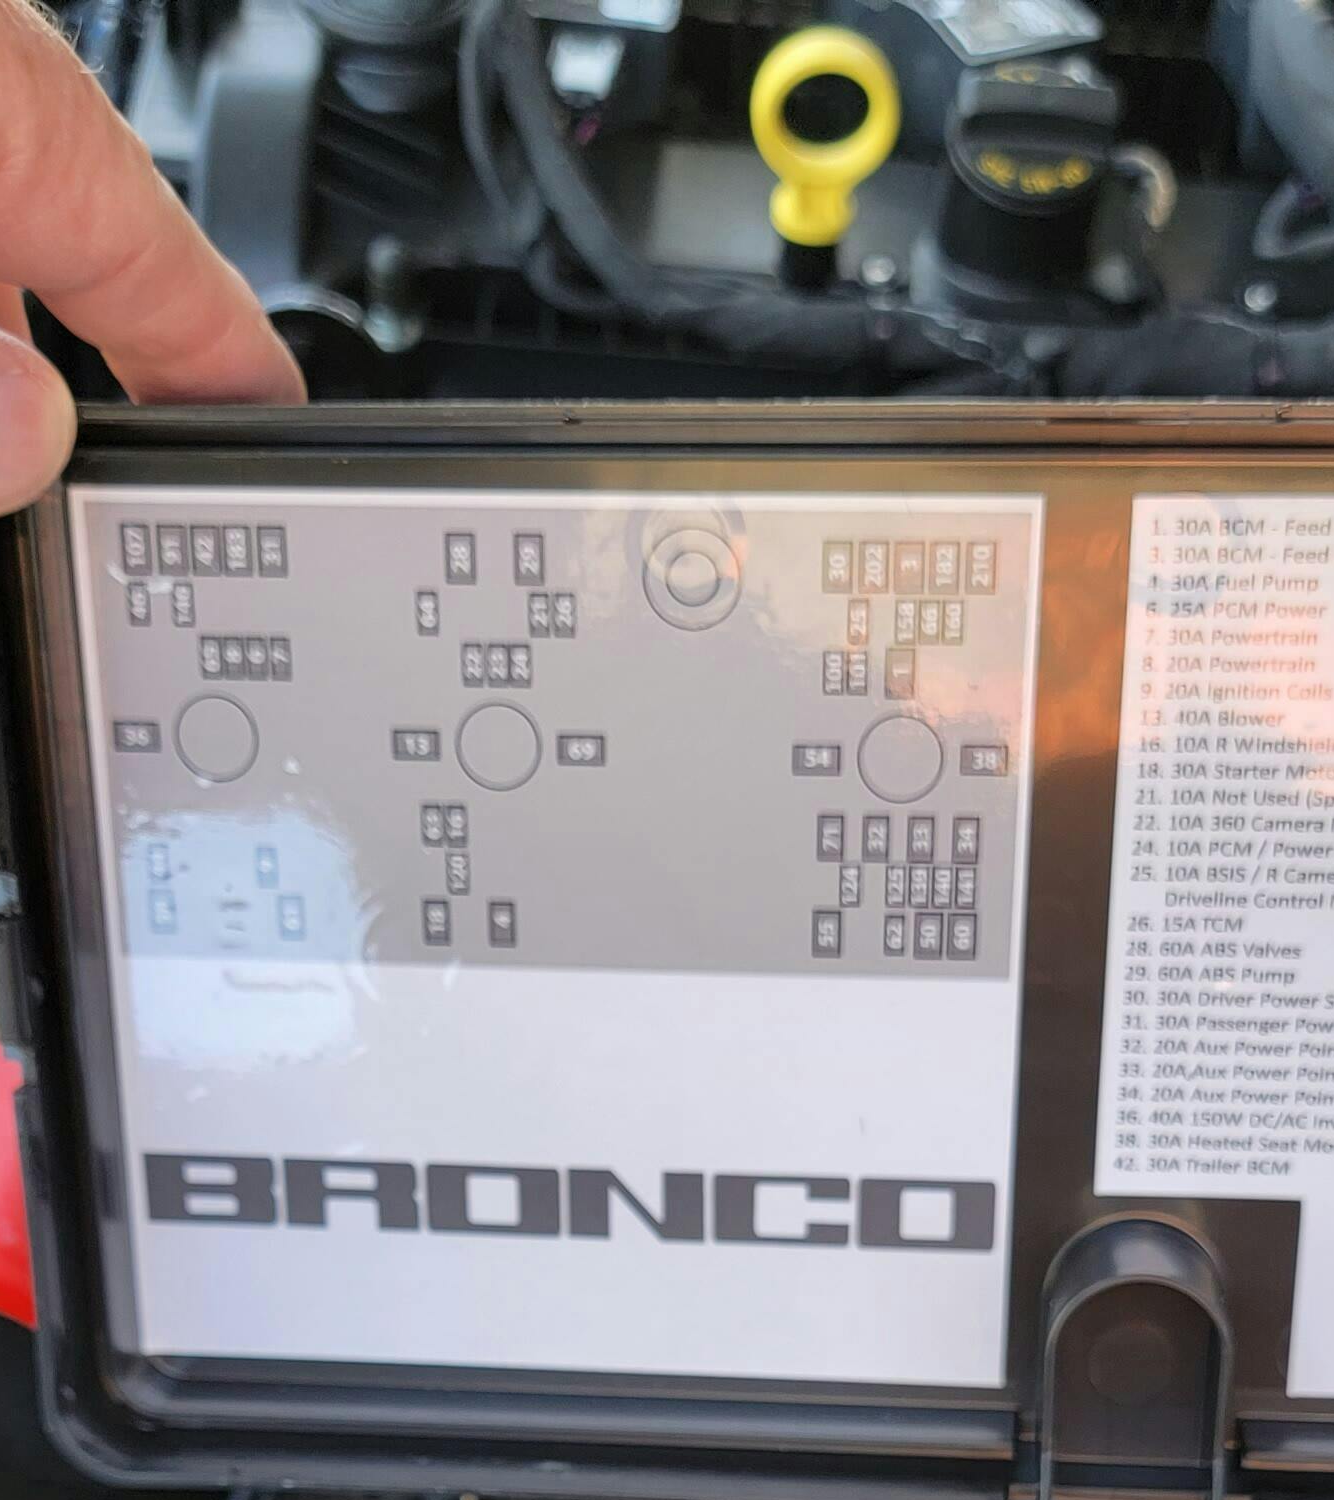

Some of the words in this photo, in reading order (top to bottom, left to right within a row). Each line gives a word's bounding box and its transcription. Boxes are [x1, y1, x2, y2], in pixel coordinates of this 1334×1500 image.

[1133, 813, 1162, 829] 22.
[1166, 813, 1206, 829] 10A
[1211, 813, 1247, 830] 360
[1249, 814, 1326, 830] Camera
[1131, 838, 1161, 854] 24.
[1165, 839, 1204, 855] 10A
[1207, 839, 1253, 855] PCM
[1272, 840, 1334, 856] Power
[1127, 914, 1156, 930] 26.
[1160, 915, 1199, 931] 15A
[1200, 915, 1244, 931] TCM
[1122, 989, 1151, 1004] 30.
[1155, 989, 1193, 1005] 30A
[1196, 990, 1255, 1006] Driver
[1259, 991, 1321, 1007] Power
[1115, 1110, 1143, 1125] 36.
[1147, 1110, 1185, 1126] 40A
[1191, 1111, 1244, 1127] 150W
[1247, 1112, 1308, 1130] DC/AC
[144, 1153, 997, 1251] BRONCO
